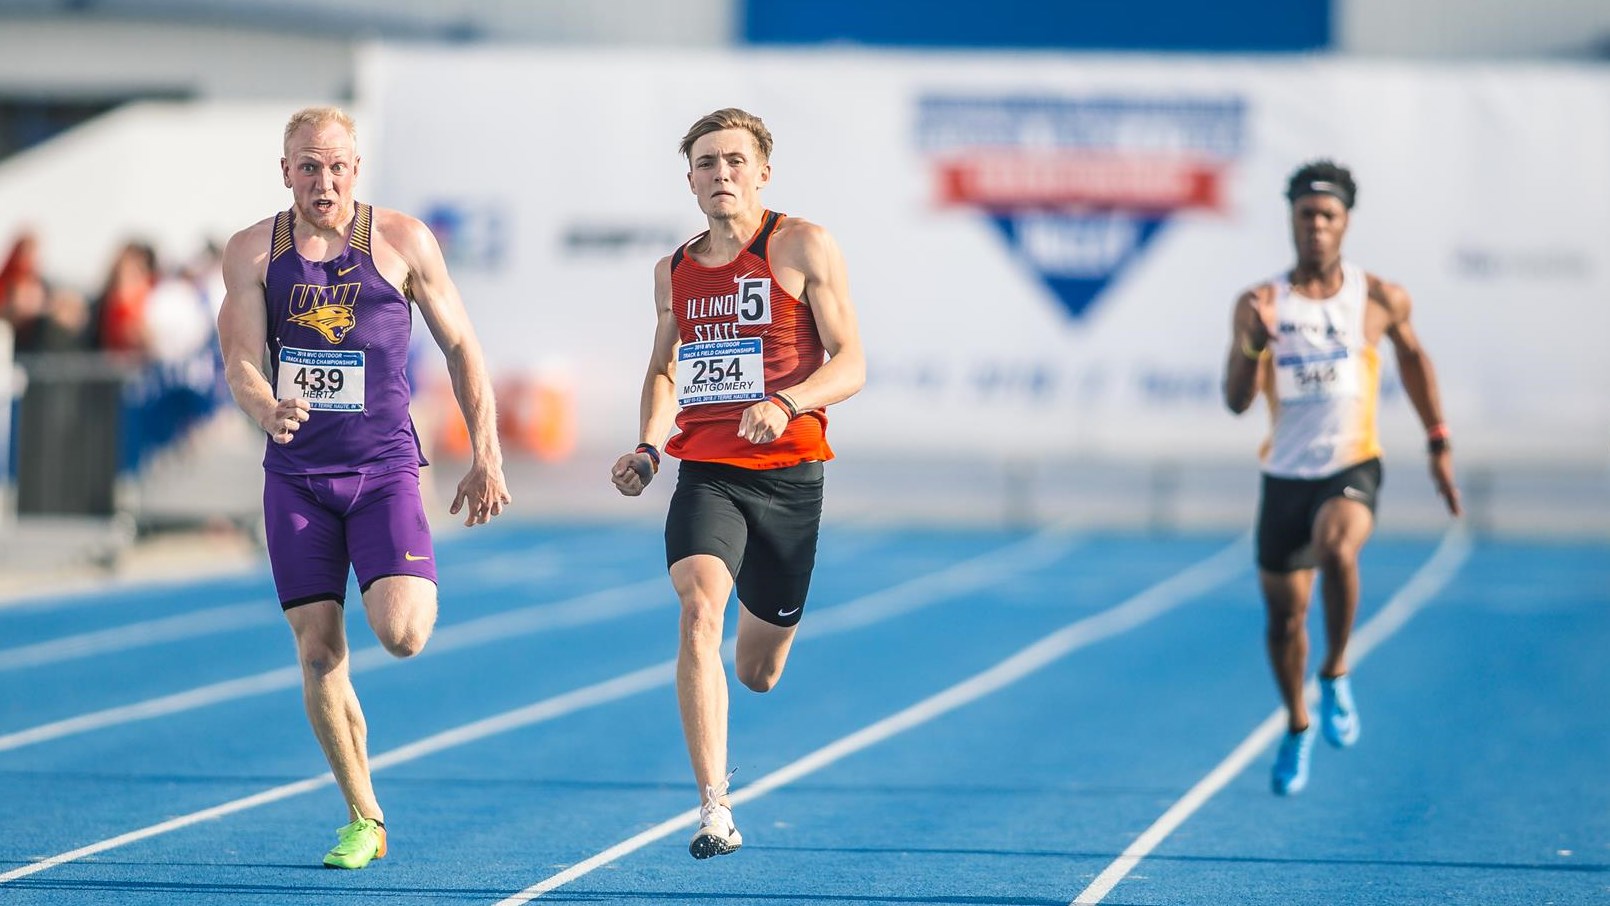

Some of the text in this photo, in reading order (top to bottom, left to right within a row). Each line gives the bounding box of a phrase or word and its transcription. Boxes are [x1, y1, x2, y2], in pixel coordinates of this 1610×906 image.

[289, 283, 361, 317] UNI
[686, 294, 739, 320] ILLINOI
[741, 281, 764, 321] 5
[715, 348, 755, 356] CHAMPIONSHIPS
[294, 368, 344, 392] 439
[692, 358, 743, 384] 254
[303, 391, 335, 399] HERTZ
[684, 382, 754, 395] MONTGOMERY
